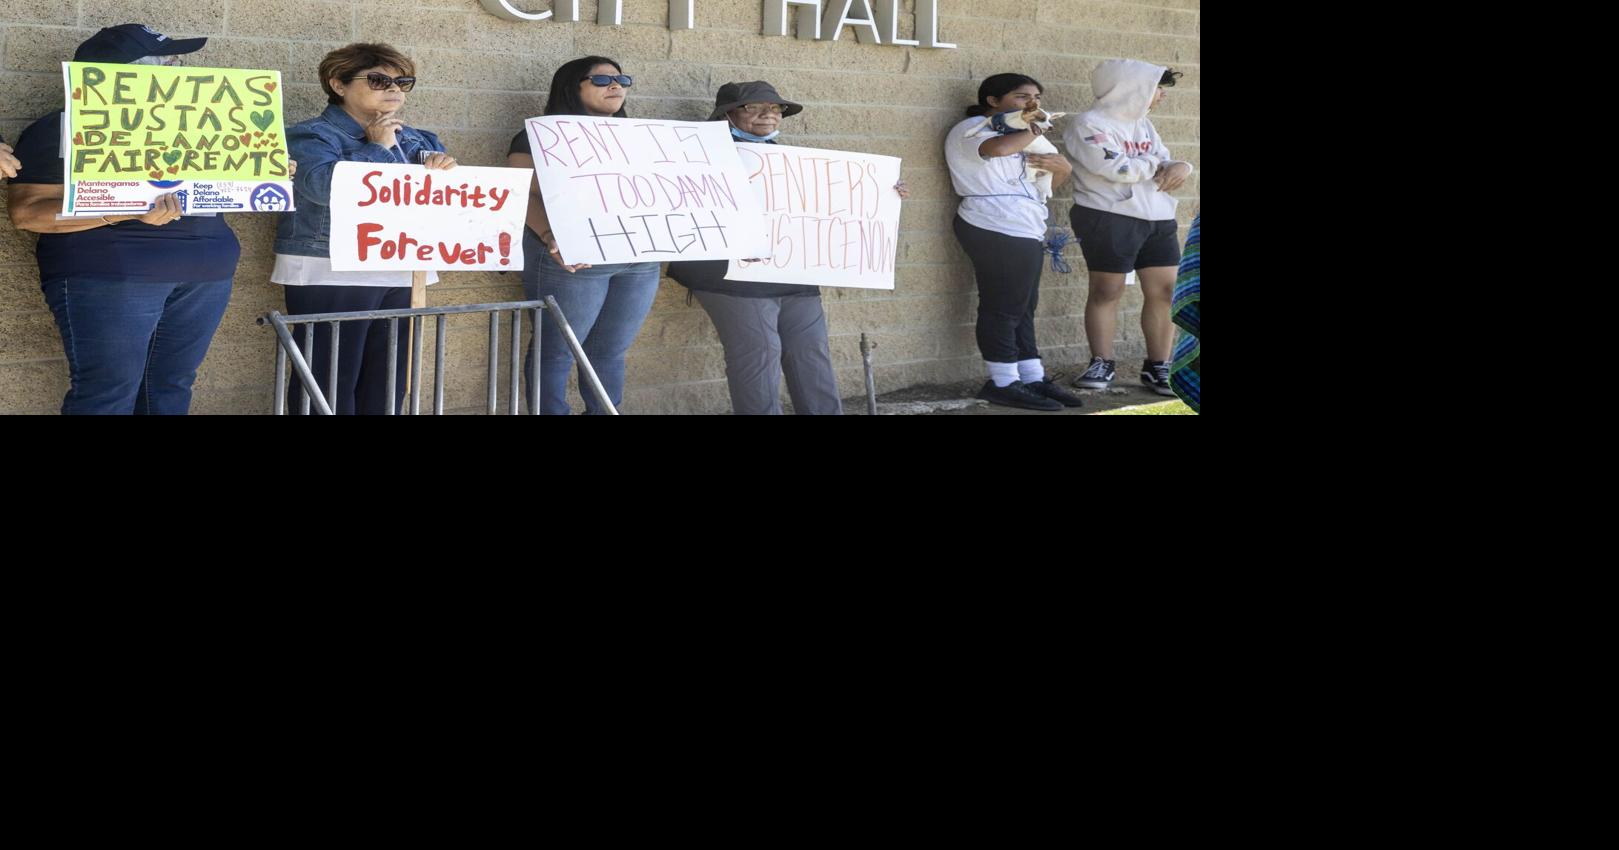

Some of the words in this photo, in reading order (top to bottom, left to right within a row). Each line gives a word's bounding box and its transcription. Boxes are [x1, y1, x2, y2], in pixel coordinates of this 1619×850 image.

[82, 66, 273, 107] RENTAS
[79, 103, 247, 133] JUSTAS
[530, 119, 631, 168] RENT
[633, 123, 711, 166] IS
[73, 149, 162, 173] FAIR
[181, 149, 288, 177] RENTS
[77, 180, 140, 189] Mantengamos
[192, 195, 234, 203] Affordable
[193, 182, 213, 190] Keep
[357, 170, 510, 211] Solidarity
[357, 223, 512, 266] Forever!
[588, 210, 728, 262] HIGH
